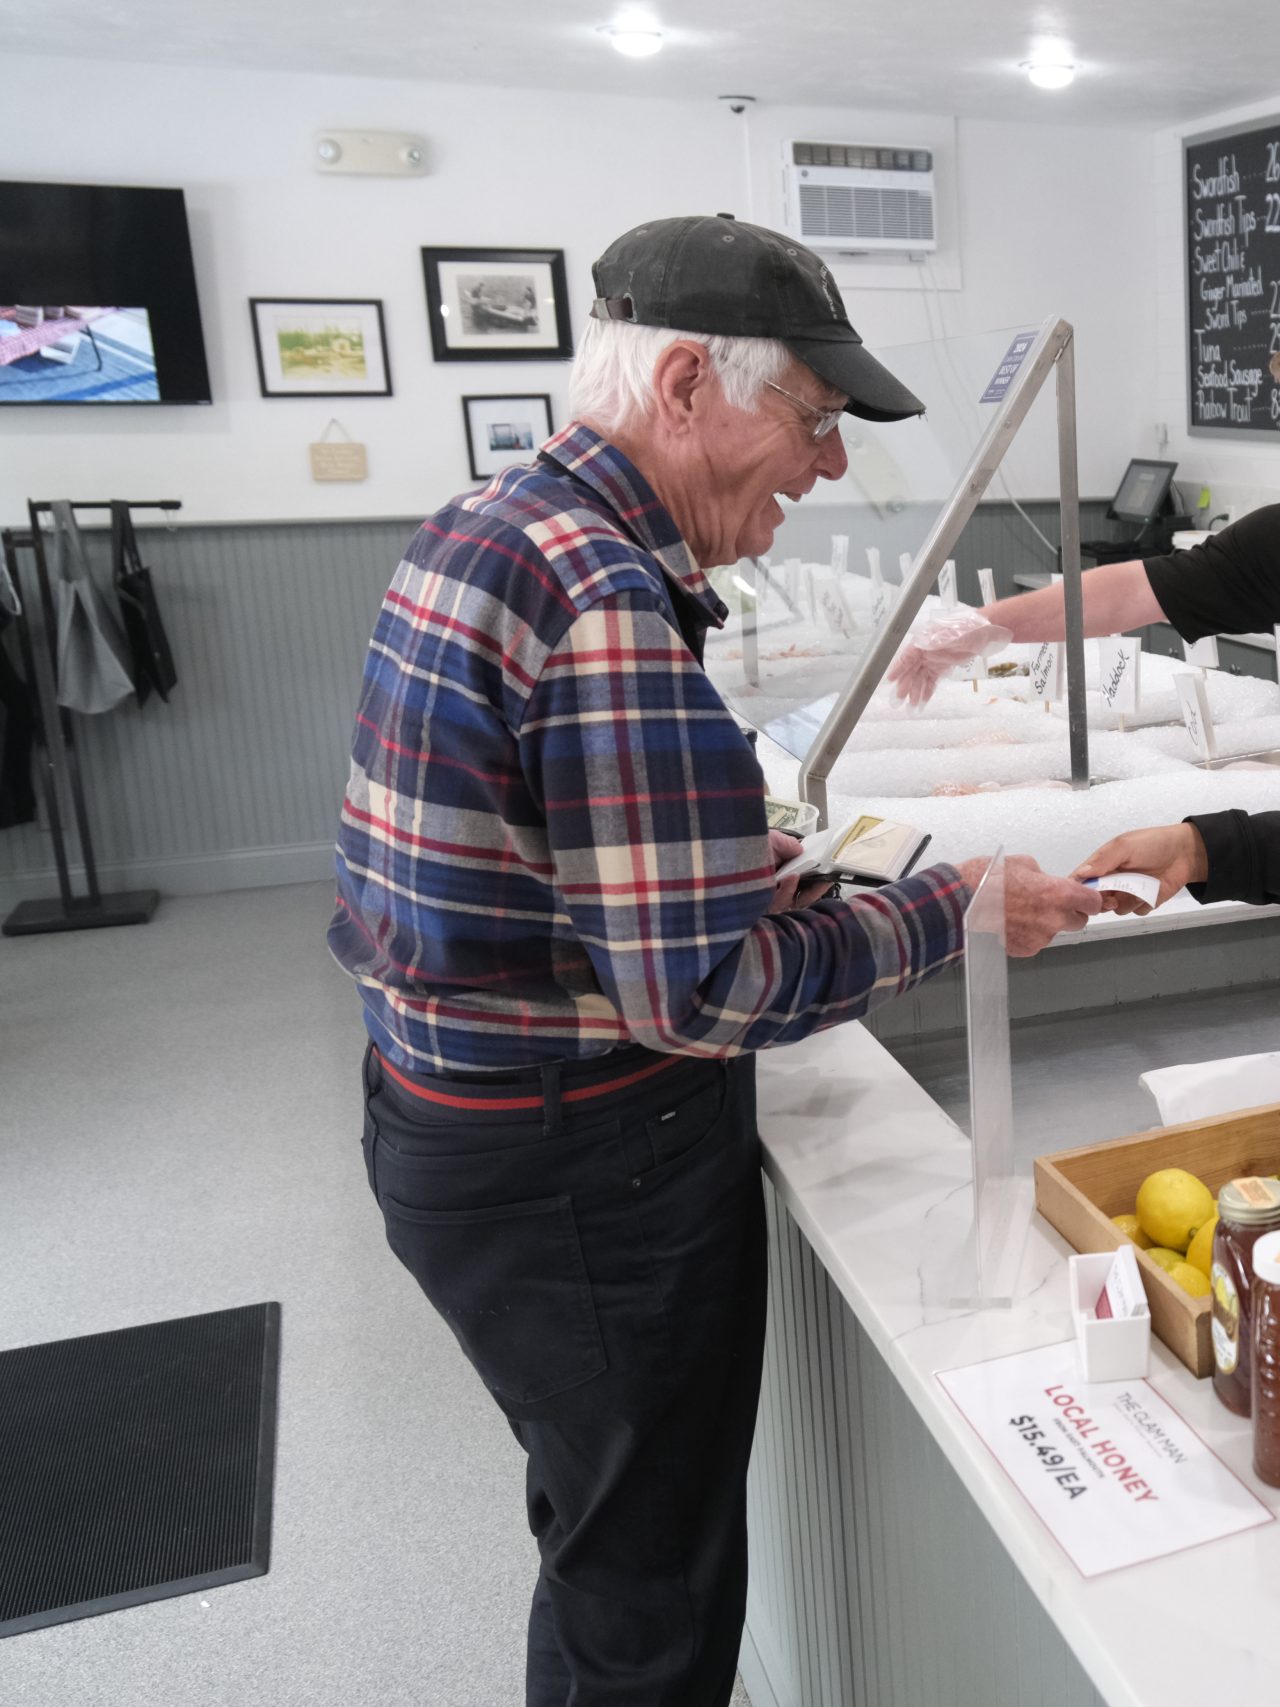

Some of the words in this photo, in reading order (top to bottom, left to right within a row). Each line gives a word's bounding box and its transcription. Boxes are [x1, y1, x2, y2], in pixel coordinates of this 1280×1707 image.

[1234, 195, 1257, 248] Tips
[1231, 300, 1248, 331] Tips
[1194, 329, 1221, 363] Tuna
[1035, 653, 1053, 695] Salmon
[1044, 1384, 1100, 1439] LOCAL
[1090, 1440, 1159, 1502] HONEY
[1117, 1392, 1142, 1413] THE
[1133, 1411, 1165, 1440] CLAM
[1159, 1437, 1188, 1464] MAN
[1008, 1415, 1088, 1500] $15.49/EA
